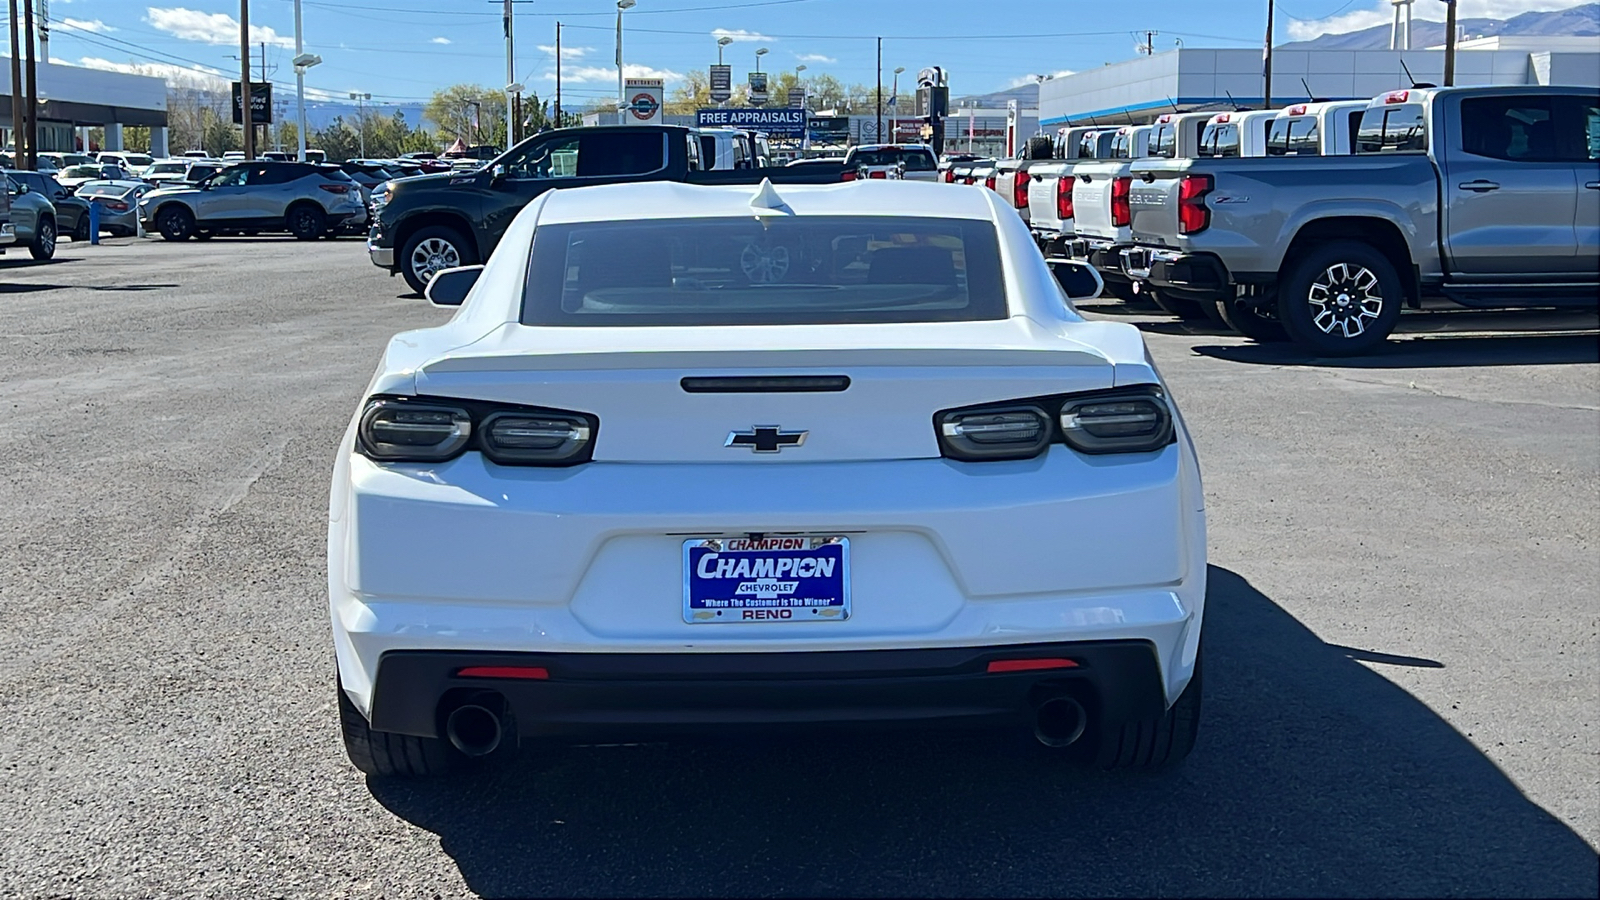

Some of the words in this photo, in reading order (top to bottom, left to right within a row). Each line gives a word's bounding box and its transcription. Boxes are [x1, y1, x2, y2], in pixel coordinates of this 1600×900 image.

[700, 112, 727, 124] FREE
[730, 112, 803, 123] APPRAISALS!
[728, 538, 804, 551] CHAMPION
[696, 553, 836, 579] CHAMPION
[739, 583, 794, 592] CHEVROLET
[730, 599, 744, 607] The
[745, 598, 780, 607] Customer
[781, 598, 789, 606] Is
[790, 598, 803, 606] The
[742, 609, 793, 620] RENO
